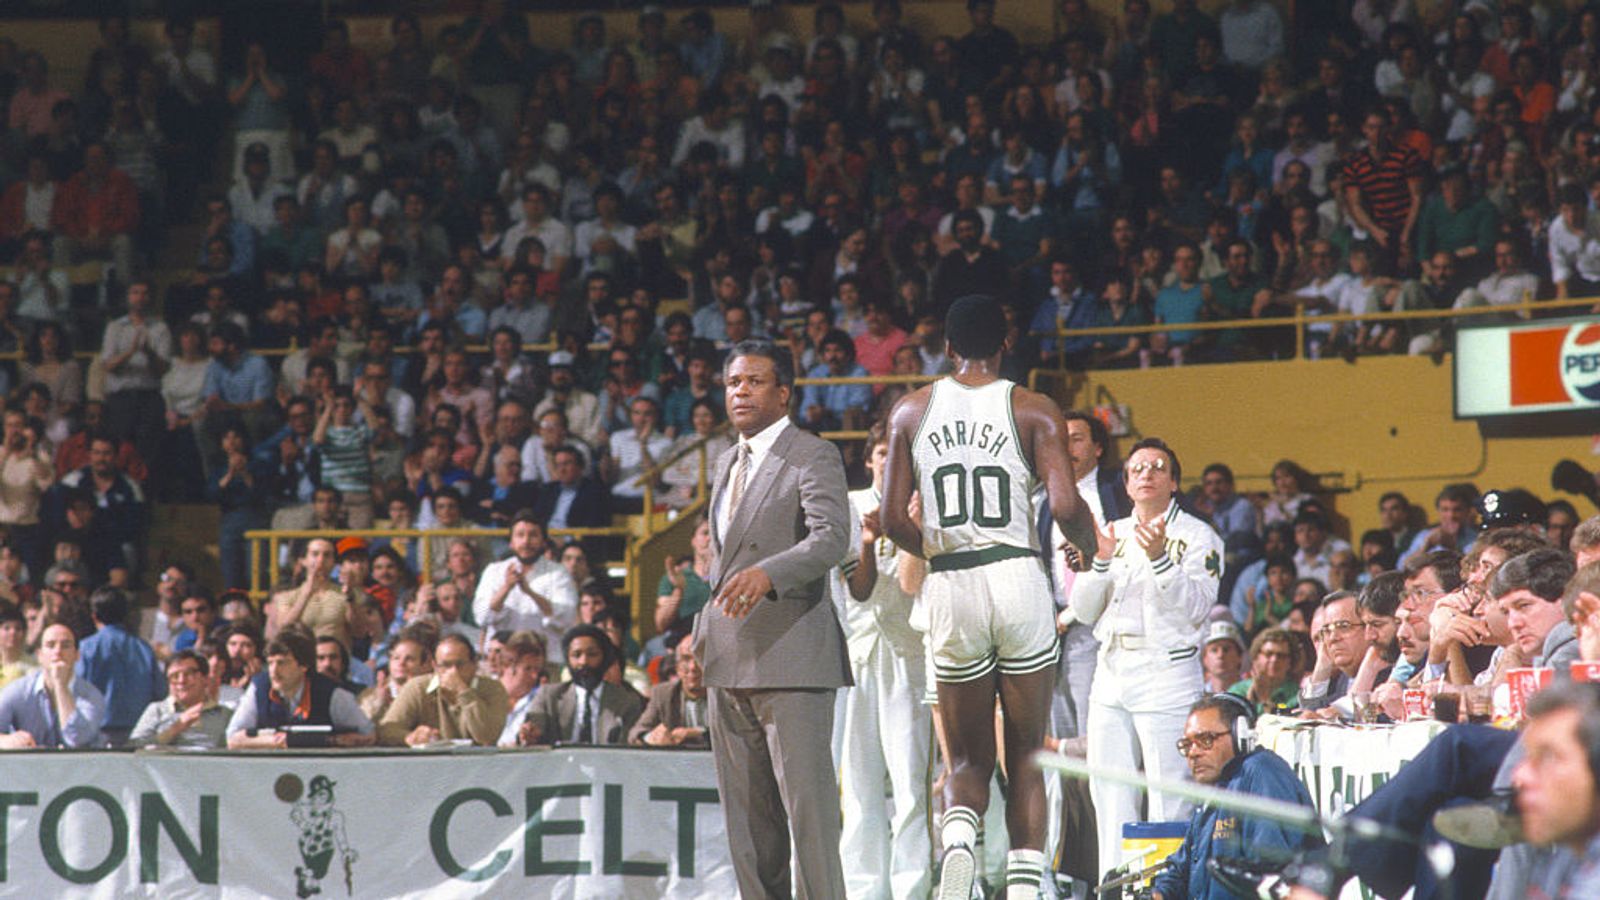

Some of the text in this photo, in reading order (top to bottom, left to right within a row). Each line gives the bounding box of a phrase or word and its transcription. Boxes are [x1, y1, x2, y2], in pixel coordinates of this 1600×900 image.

[928, 420, 1008, 457] PARISH
[932, 463, 1011, 528] 00
[429, 783, 719, 882] CELT
